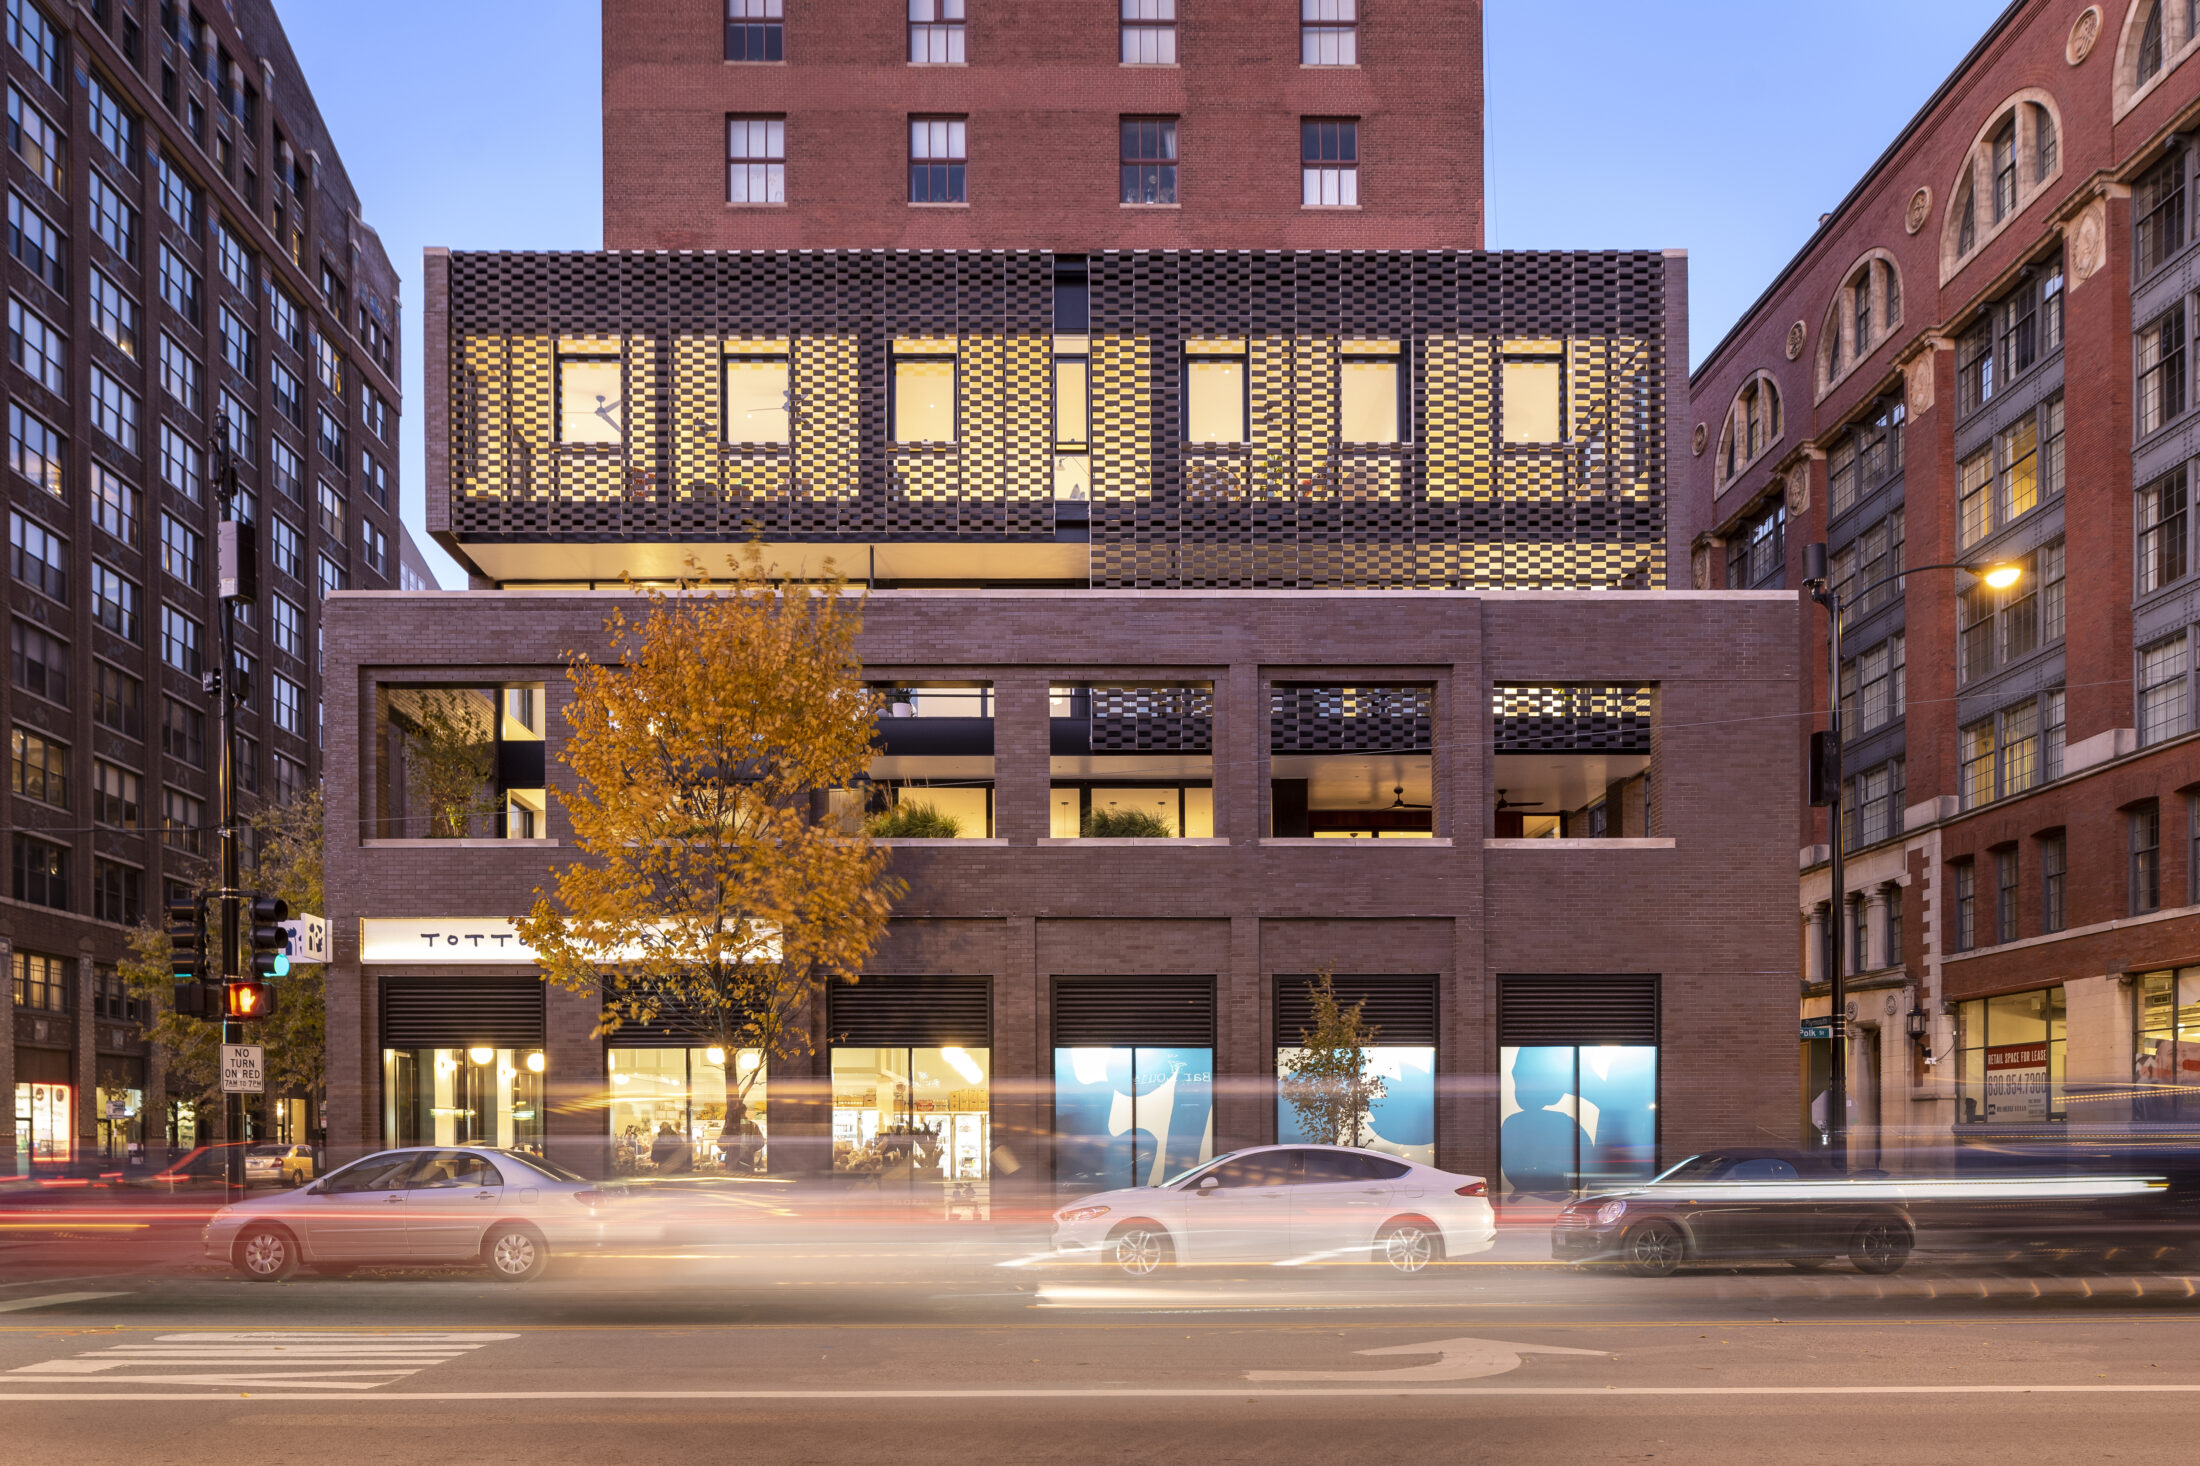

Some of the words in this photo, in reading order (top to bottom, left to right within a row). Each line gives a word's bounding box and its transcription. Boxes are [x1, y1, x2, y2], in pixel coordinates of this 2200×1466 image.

[1800, 1029, 1816, 1037] Polk
[235, 1049, 249, 1058] NO
[1988, 1054, 2003, 1064] RETAIL
[2004, 1052, 2019, 1064] SPACE
[2020, 1050, 2030, 1062] FOR
[2031, 1049, 2046, 1061] LEASE
[230, 1059, 254, 1068] TURN
[225, 1069, 237, 1078] ON
[243, 1070, 260, 1078] RED
[1988, 1072, 2047, 1096] 630.954.7300
